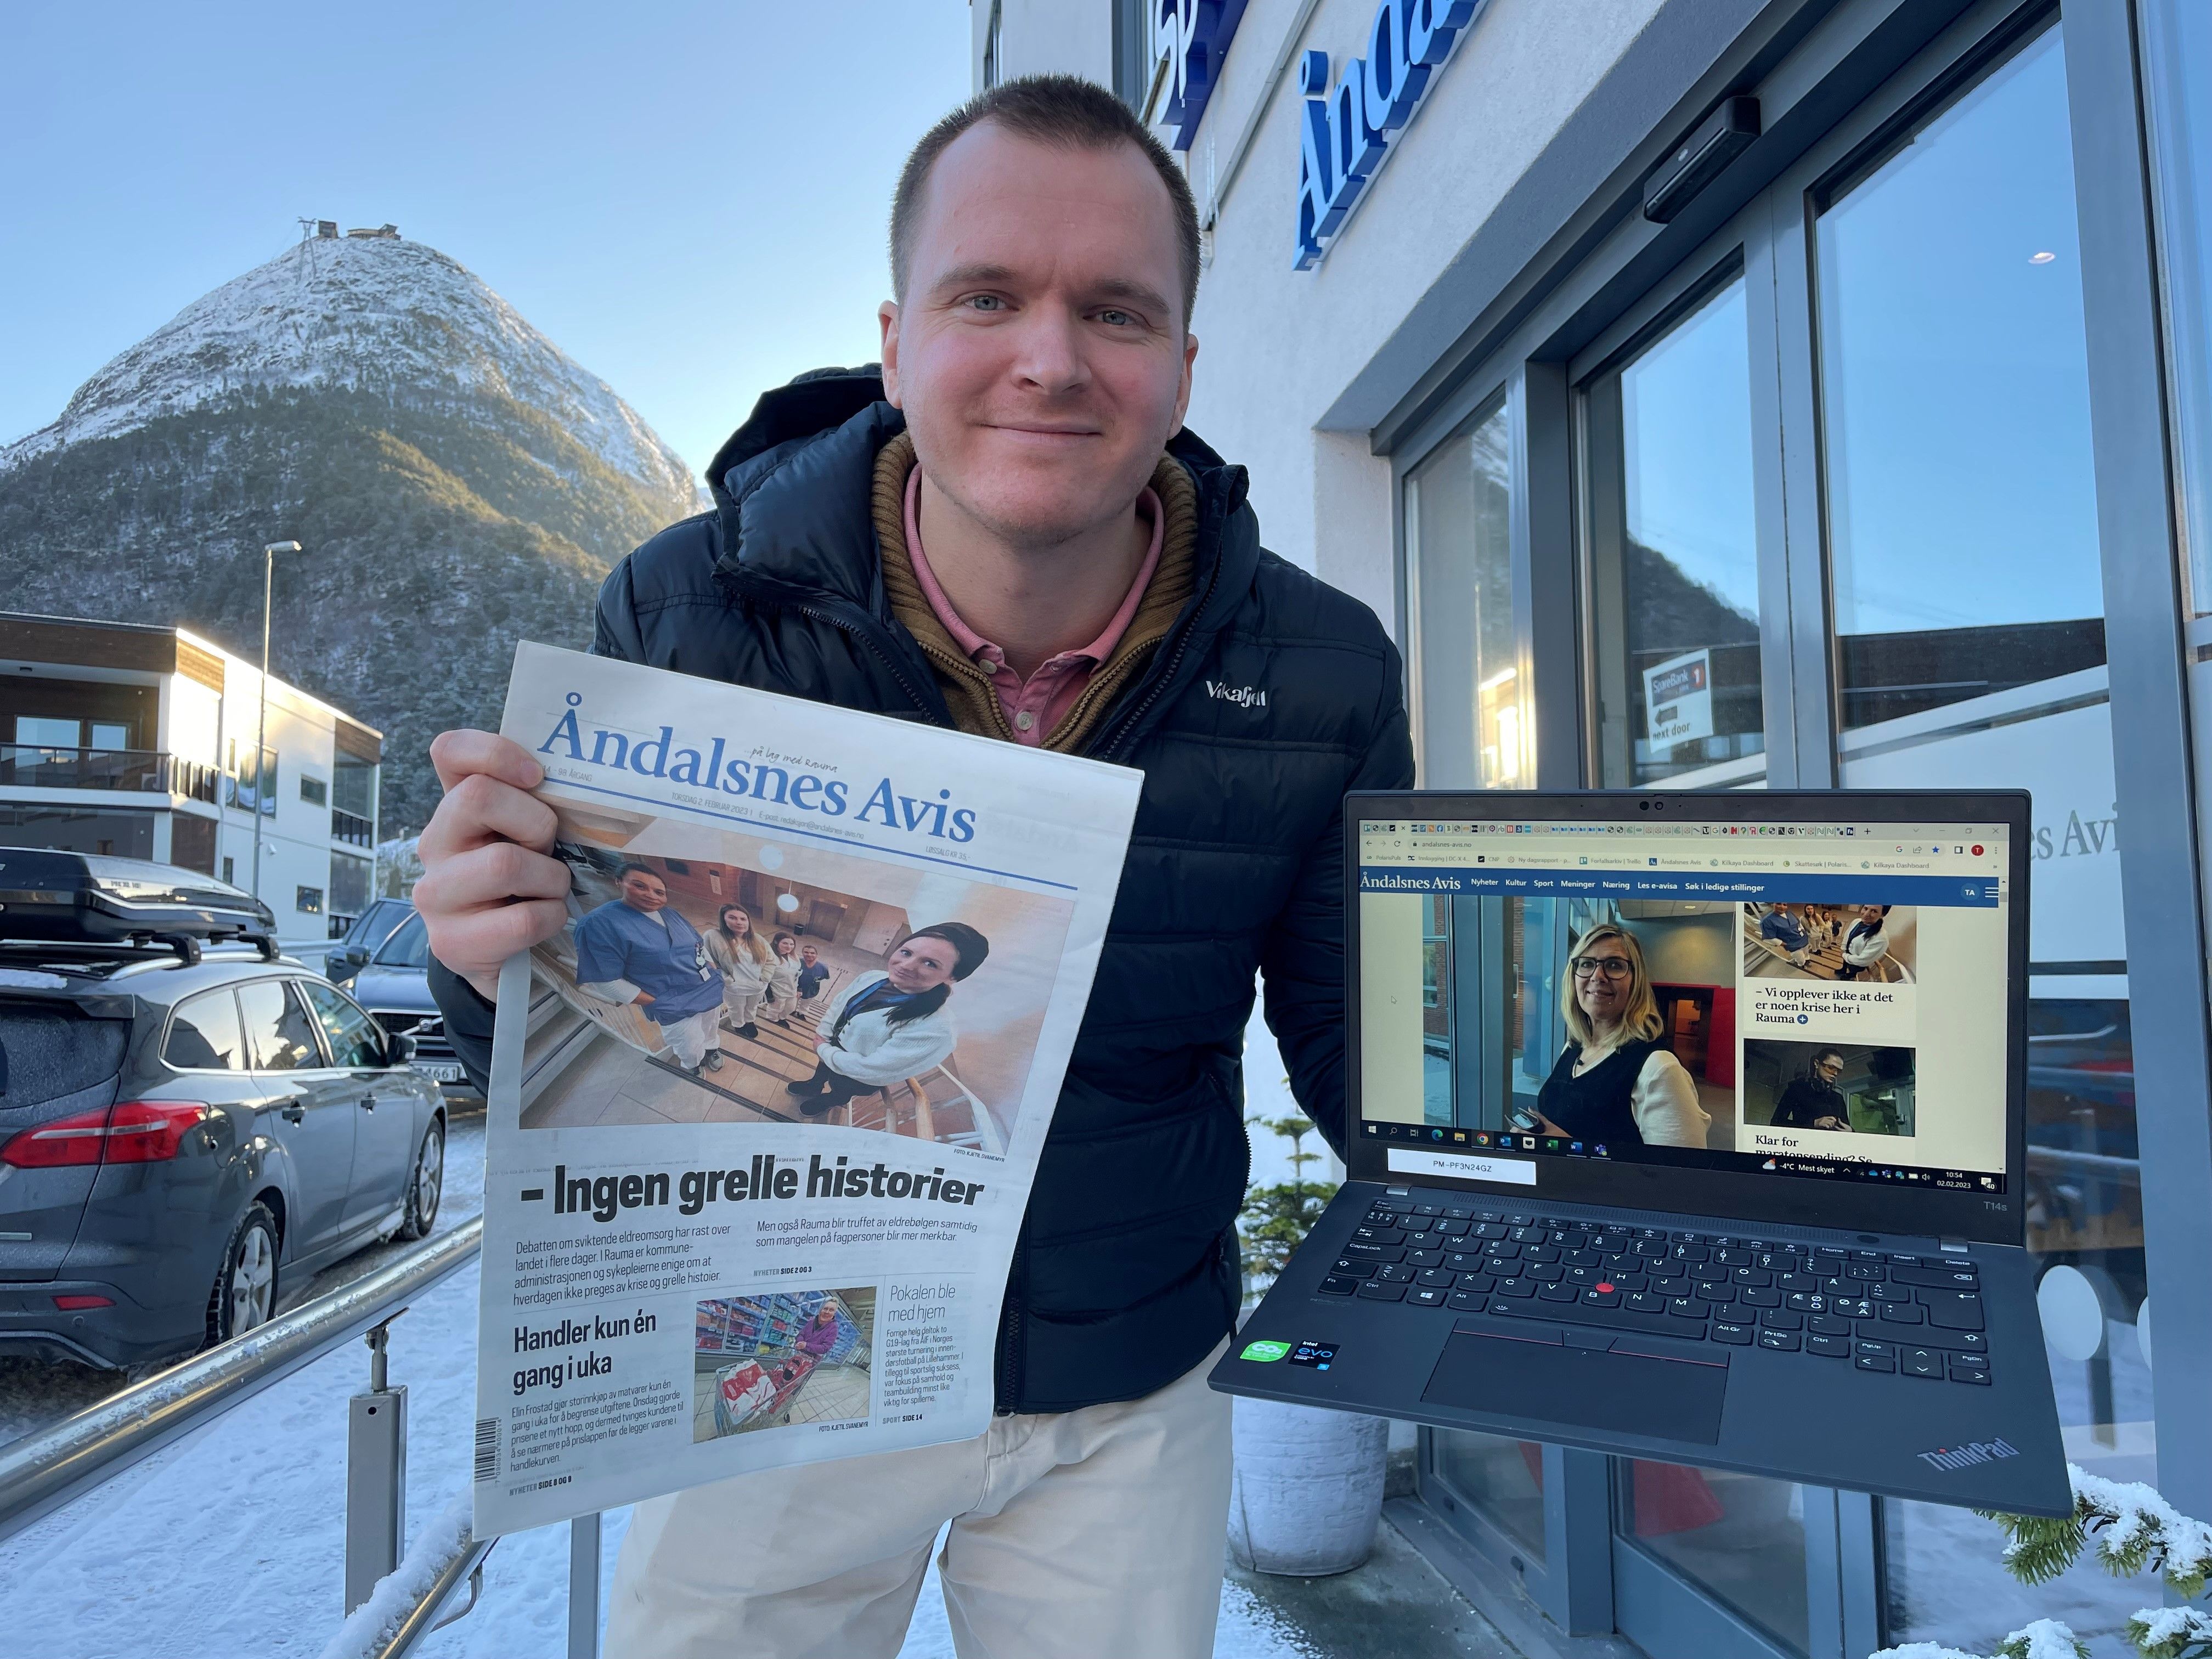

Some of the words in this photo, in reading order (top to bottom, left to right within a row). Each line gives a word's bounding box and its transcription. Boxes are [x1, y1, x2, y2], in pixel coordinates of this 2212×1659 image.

[1206, 680, 1266, 708] Vikafjell
[1652, 727, 1669, 741] next
[1672, 723, 1691, 736] door
[766, 747, 780, 763] lag
[783, 754, 803, 765] med
[537, 692, 848, 816] Åndalsnes
[854, 777, 977, 843] Avis
[2060, 802, 2119, 857] Avi
[1359, 871, 1430, 889] Åndalsnes
[1432, 877, 1461, 890] Avis
[1471, 878, 1499, 887] Nyheter
[1561, 880, 1596, 889] Meninger
[1602, 881, 1630, 890] Næring
[1706, 883, 1729, 893] ledige
[1731, 883, 1765, 893] stillinger
[1765, 988, 1776, 997] Vi
[1779, 988, 1830, 1001] opplever
[1832, 990, 1857, 1001] ikke
[1860, 993, 1872, 1001] at
[1874, 992, 1894, 1002] det
[1770, 1003, 1798, 1011] noen
[1802, 1002, 1831, 1013] krise
[1833, 1003, 1854, 1013] her
[1857, 1004, 1860, 1014] i
[1756, 1013, 1795, 1024] Rauma
[1756, 1135, 1780, 1146] Klar
[1782, 1137, 1799, 1147] for
[1433, 1160, 1492, 1172] PM-PF3N24GZ
[1798, 1164, 1815, 1172] Mest
[1817, 1165, 1835, 1174] skyet
[554, 1164, 669, 1222] Ingen
[679, 1154, 799, 1215] grelle
[805, 1154, 985, 1206] historier
[1937, 1180, 1971, 1188] 02.02.2023
[1983, 1201, 2007, 1211] T14s
[757, 1221, 776, 1232] Men
[777, 1219, 799, 1234] også
[800, 1219, 830, 1229] Rauma
[831, 1217, 845, 1228] blir
[847, 1217, 876, 1228] truffet
[888, 1216, 939, 1231] eldrebølgen
[940, 1219, 977, 1234] samtidig
[516, 1240, 557, 1254] Debatten
[558, 1240, 573, 1250] om
[574, 1233, 617, 1249] sviktende
[618, 1230, 673, 1244] eldreomsorg
[675, 1226, 690, 1239] har
[691, 1224, 710, 1237] rast
[711, 1224, 730, 1235] over
[755, 1238, 775, 1247] som
[776, 1234, 819, 1248] mangelen
[820, 1233, 832, 1247] på
[833, 1232, 885, 1246] fagpersoner
[887, 1230, 900, 1240] blir
[515, 1257, 544, 1271] landet
[545, 1256, 549, 1268] i
[549, 1255, 569, 1268] flere
[604, 1249, 633, 1262] Rauma
[635, 1249, 644, 1258] er
[645, 1243, 692, 1257] kommune-
[514, 1271, 591, 1289] administrasjonen
[592, 1269, 604, 1282] og
[606, 1263, 659, 1281] sykepleierne
[661, 1259, 684, 1274] enige
[686, 1259, 700, 1269] om
[702, 1256, 712, 1267] at
[753, 1268, 780, 1277] NYHETER
[513, 1291, 562, 1306] hverdagen
[563, 1286, 583, 1300] ikke
[584, 1285, 614, 1301] preges
[616, 1283, 625, 1294] av
[627, 1279, 648, 1292] krise
[649, 1279, 660, 1292] og
[662, 1274, 685, 1291] grelle
[890, 1285, 935, 1301] Pokalen
[938, 1284, 955, 1299] ble
[888, 1306, 915, 1322] med
[917, 1305, 945, 1324] hjem
[514, 1319, 591, 1353] Handler
[595, 1315, 630, 1340] kun
[634, 1308, 656, 1334] én
[1299, 1348, 1333, 1358] evo
[514, 1364, 563, 1396] gang
[568, 1355, 573, 1380] i
[577, 1351, 612, 1379] uka
[882, 1416, 901, 1424] SPORT
[1917, 1436, 2021, 1471] ThinkPad
